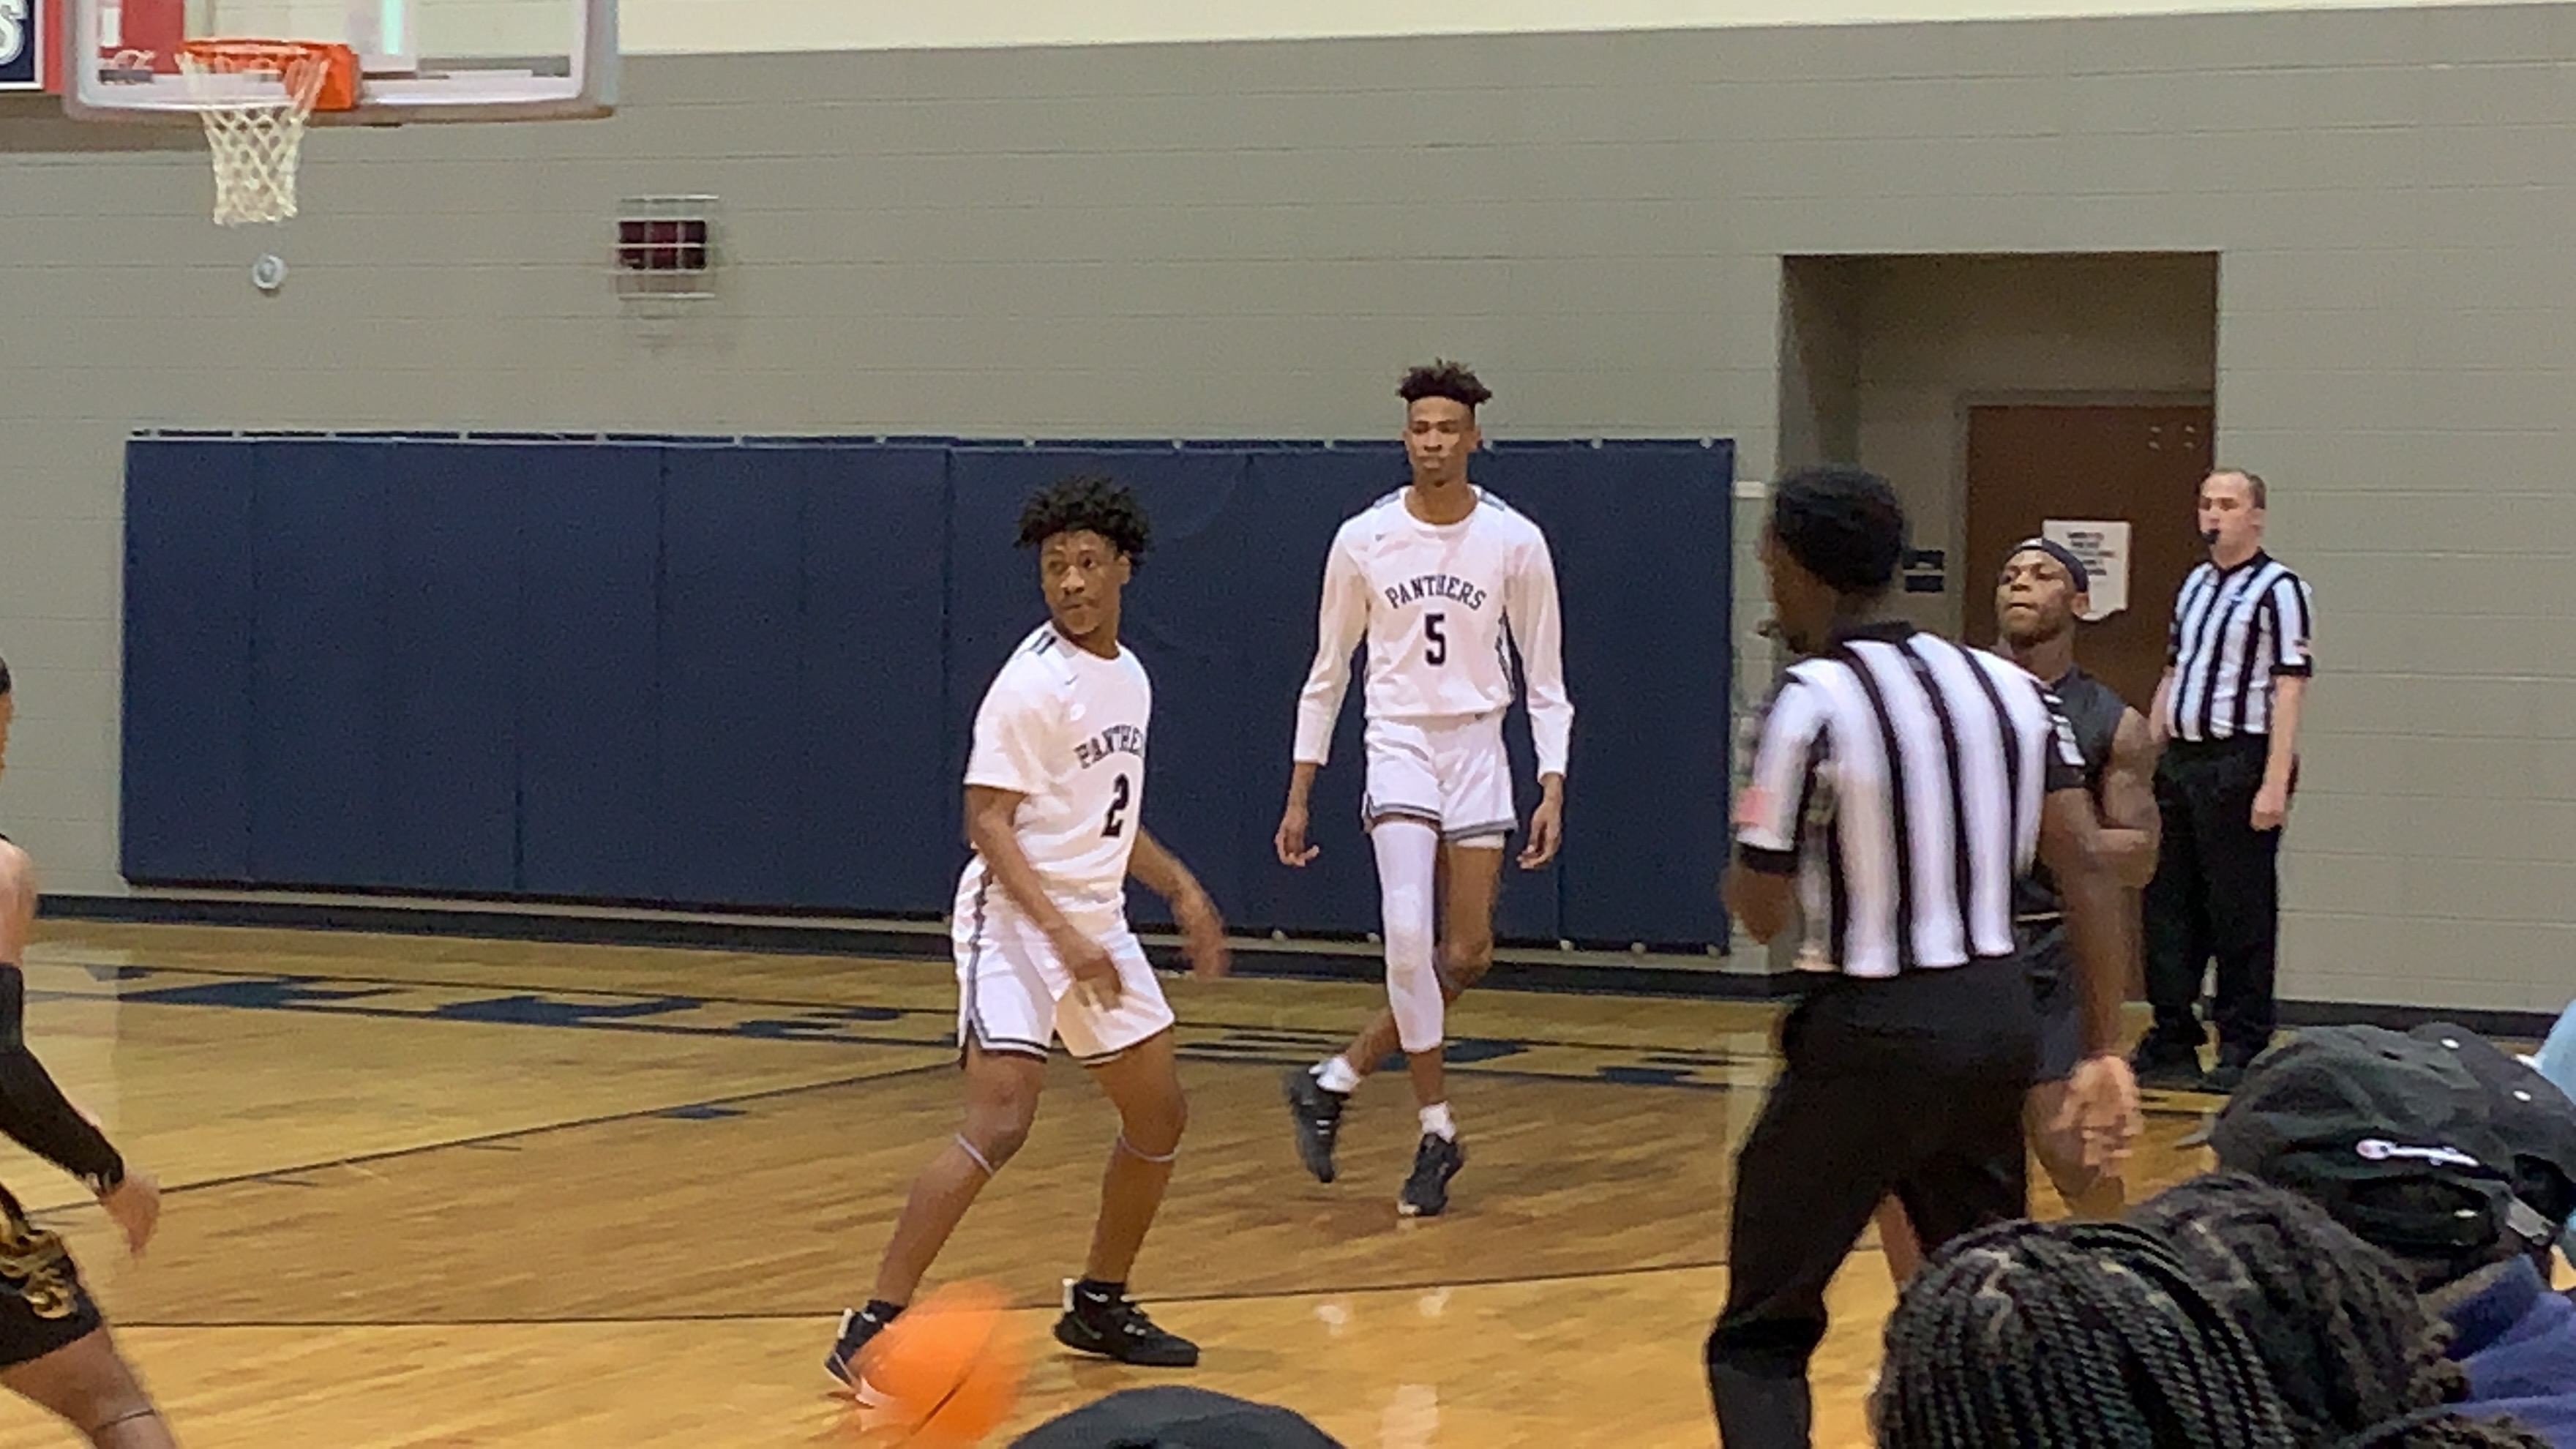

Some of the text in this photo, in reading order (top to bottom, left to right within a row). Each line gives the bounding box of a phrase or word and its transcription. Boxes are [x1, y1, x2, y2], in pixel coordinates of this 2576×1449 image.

[1385, 574, 1486, 610] PANTHERS
[1424, 613, 1446, 667] 5
[1100, 773, 1130, 838] 2
